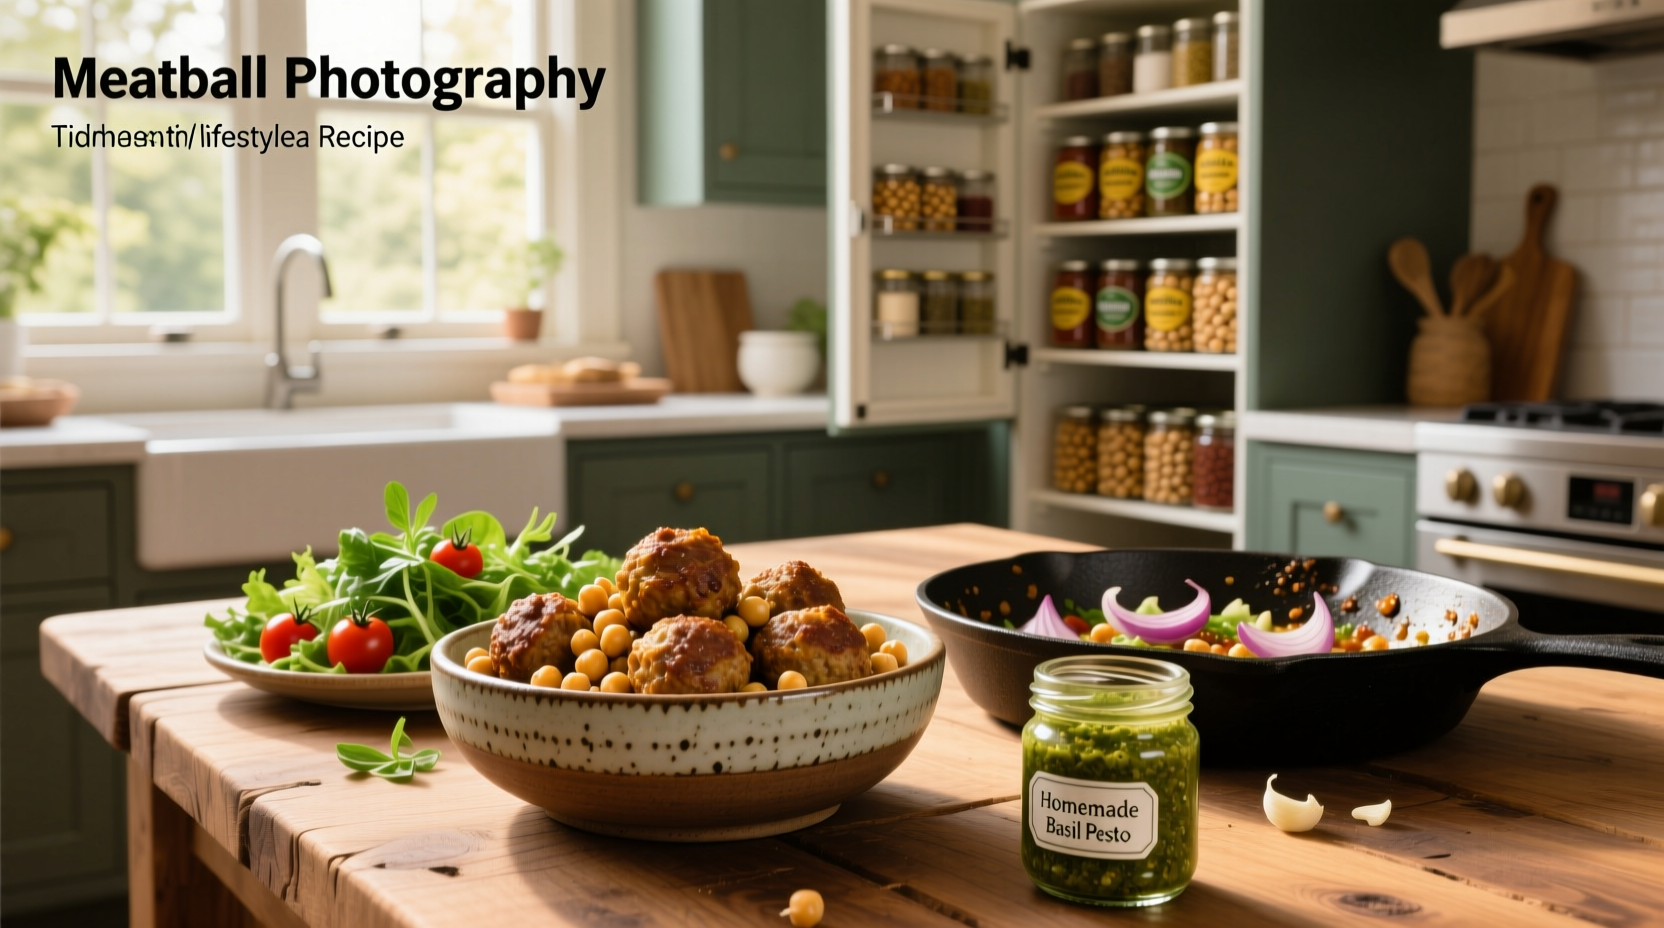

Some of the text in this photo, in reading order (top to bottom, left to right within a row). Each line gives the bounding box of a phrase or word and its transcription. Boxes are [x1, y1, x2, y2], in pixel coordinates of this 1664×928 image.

[1040, 790, 1139, 819] Homemade
[1046, 816, 1131, 843] Basil Pesto
